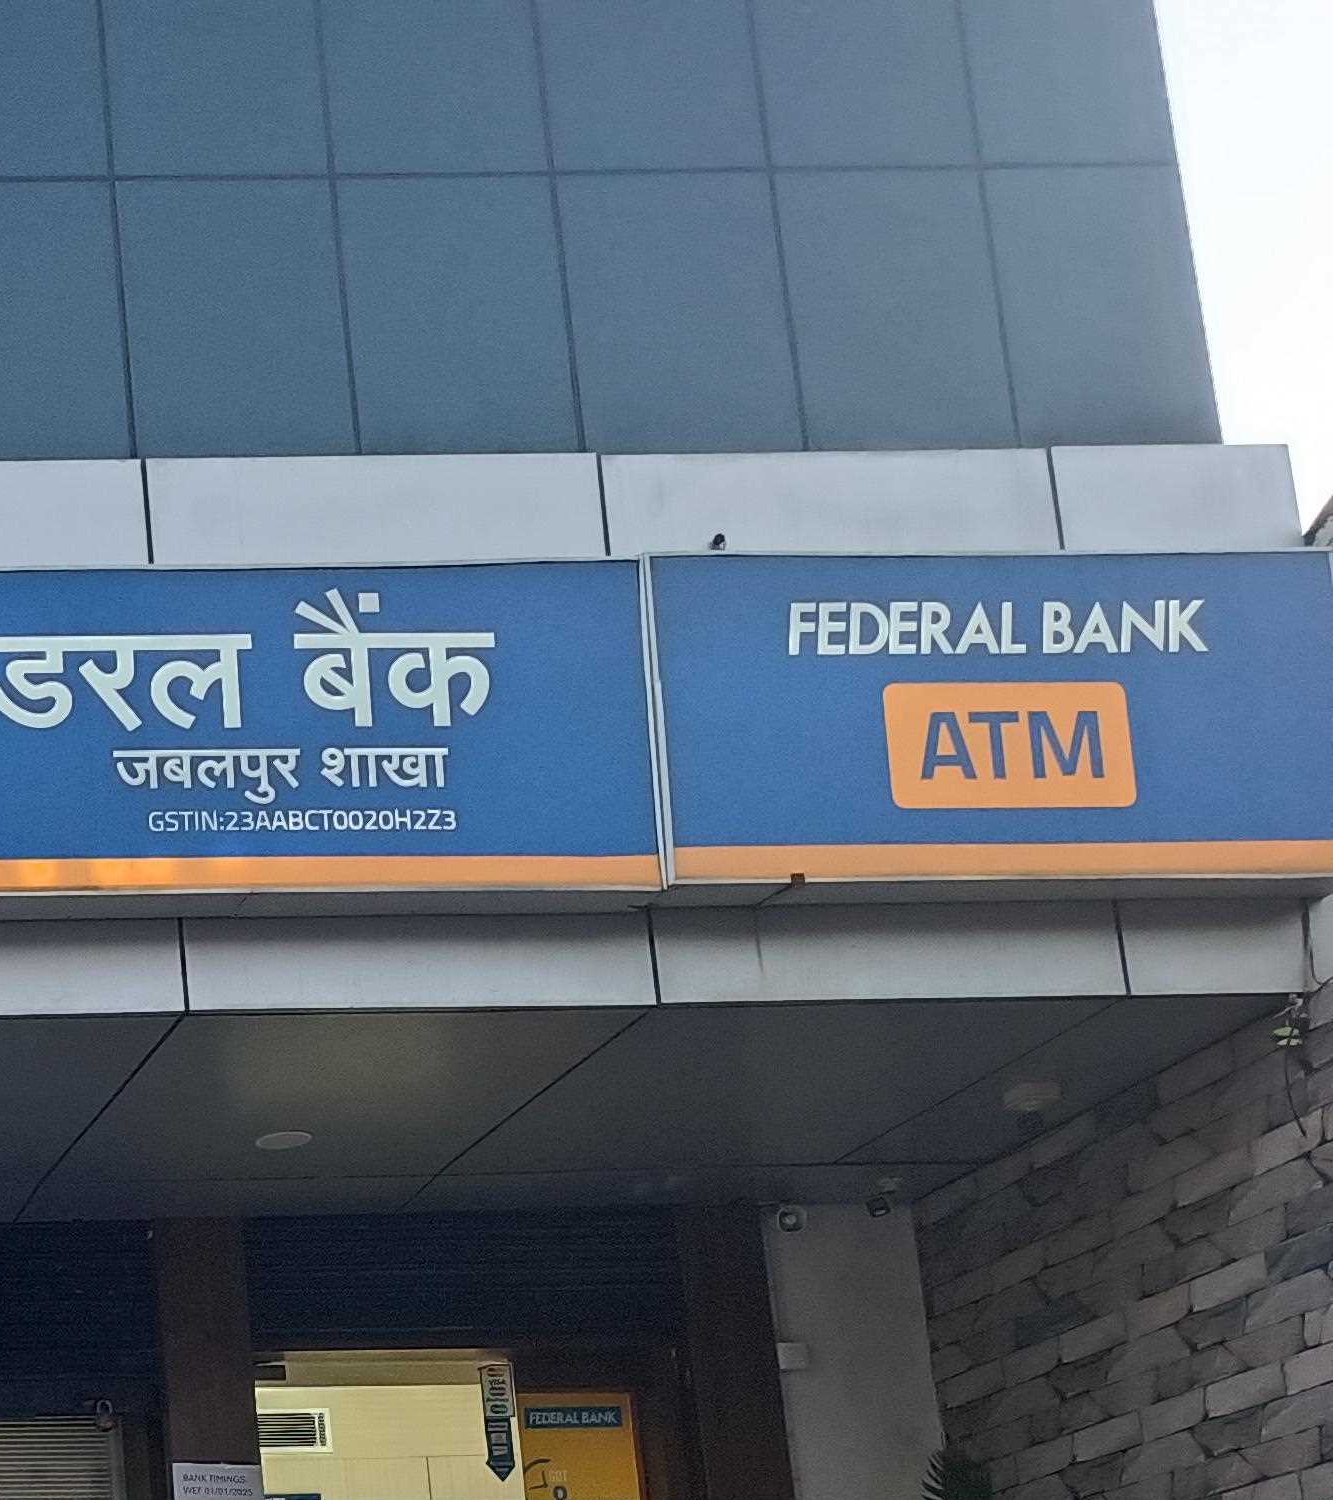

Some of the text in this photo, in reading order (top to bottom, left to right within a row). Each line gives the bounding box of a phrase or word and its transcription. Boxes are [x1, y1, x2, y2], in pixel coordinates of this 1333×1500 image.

[788, 599, 1209, 656] FEDERAL BANK
[293, 588, 495, 728] बैंक
[920, 710, 1105, 780] ATM
[112, 746, 449, 804] जबलपुर शाखा
[147, 809, 457, 833] GSTIN:23AABCT0020H2Z3
[529, 1410, 618, 1424] FEDERAL BANK
[182, 1473, 246, 1483] BANK TIMINGS
